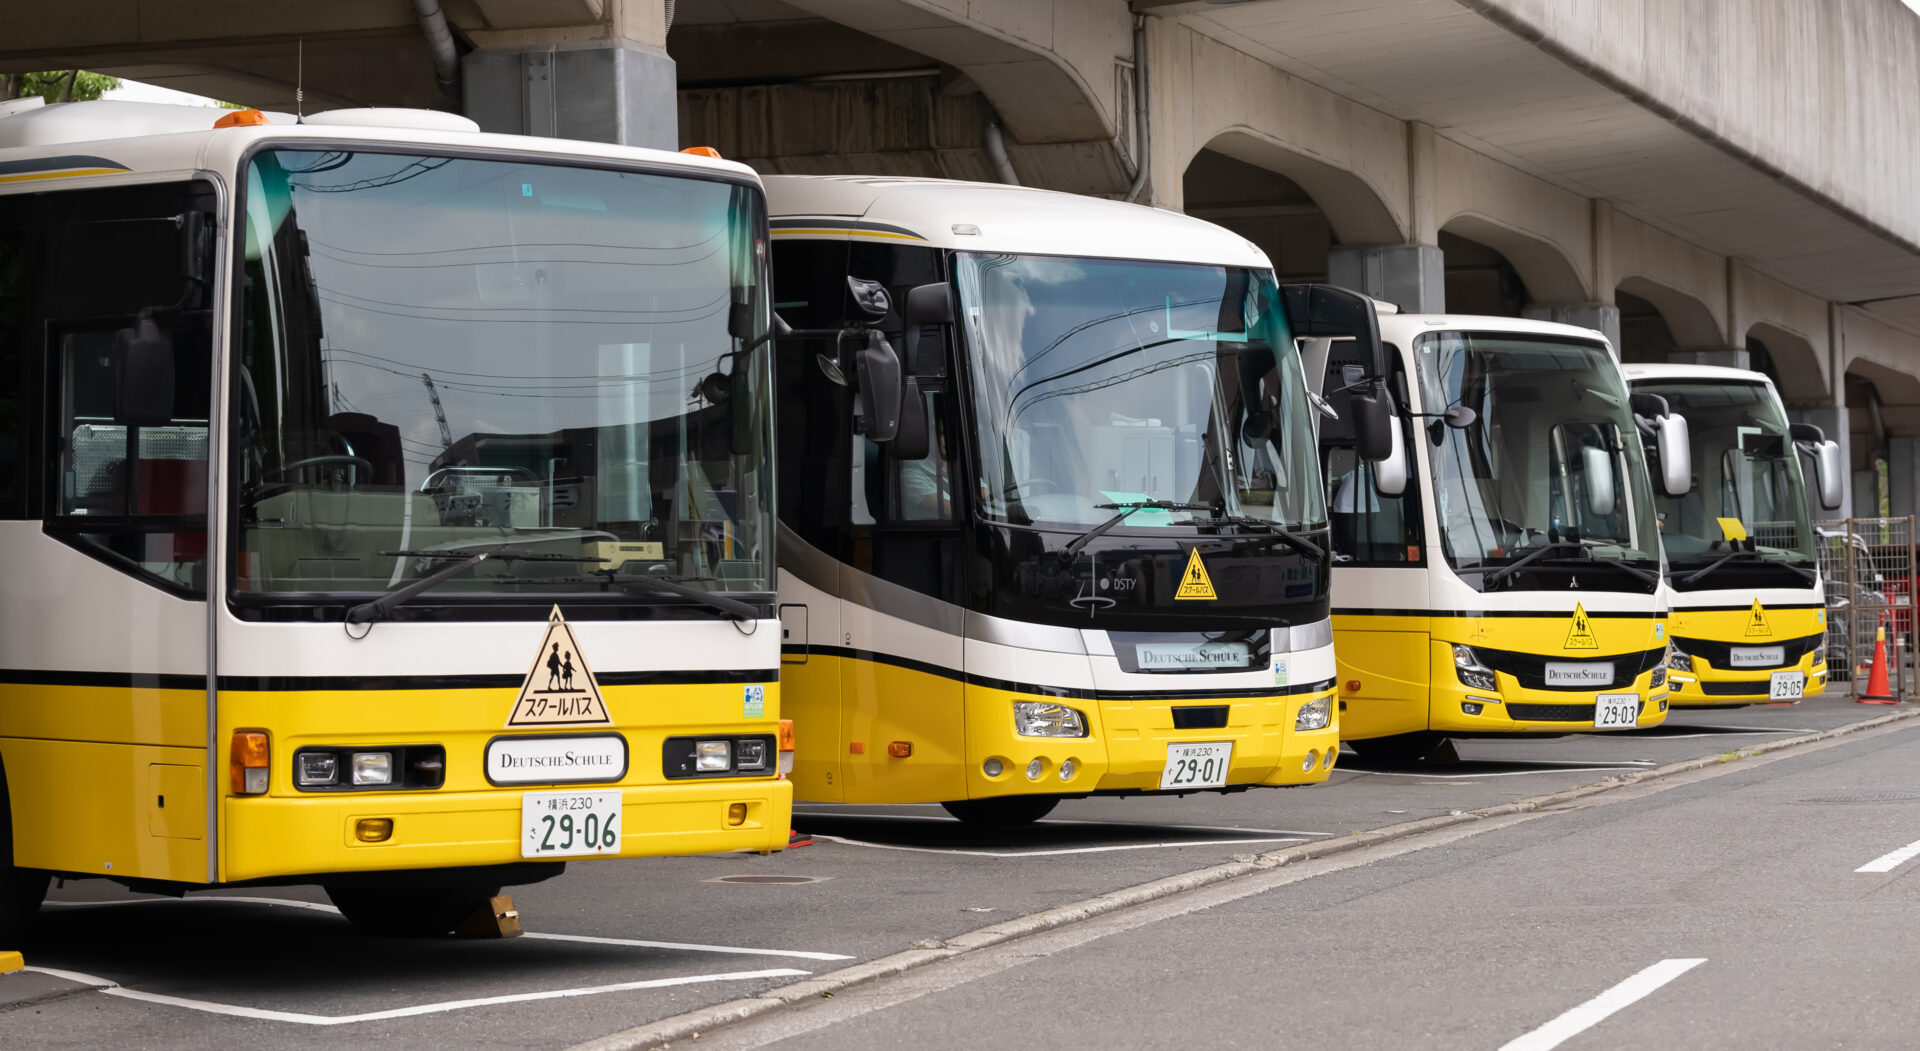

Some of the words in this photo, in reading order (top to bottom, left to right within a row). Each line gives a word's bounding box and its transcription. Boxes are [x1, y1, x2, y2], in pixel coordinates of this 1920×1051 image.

[1114, 578, 1136, 590] DSTY
[1184, 586, 1209, 594] スクールバス
[525, 697, 592, 716] スクールバス
